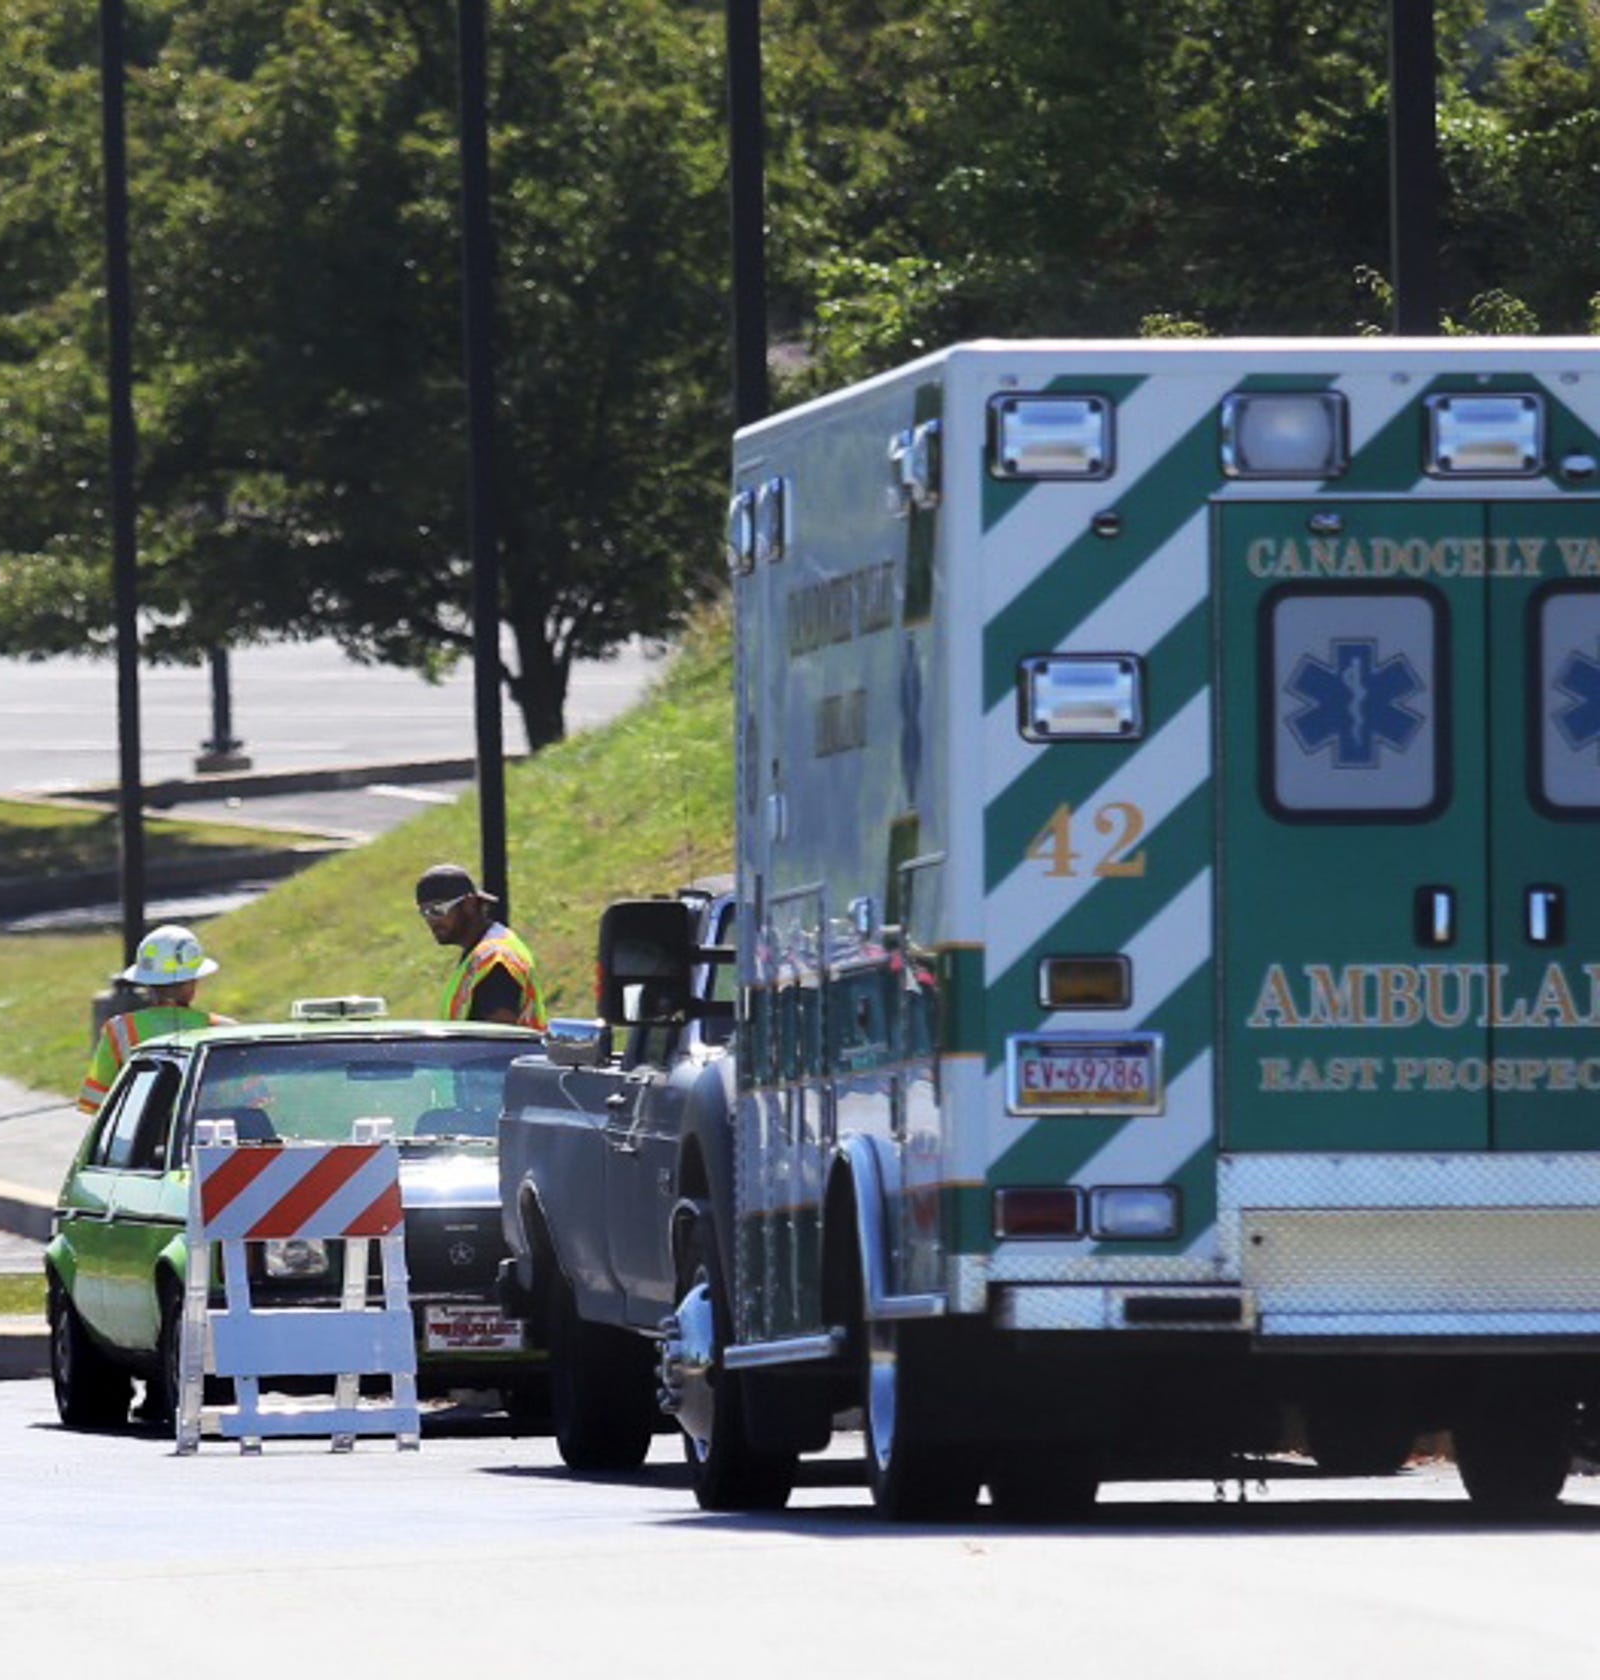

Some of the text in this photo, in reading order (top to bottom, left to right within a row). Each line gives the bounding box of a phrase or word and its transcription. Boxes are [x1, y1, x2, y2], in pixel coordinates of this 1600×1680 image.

[1025, 801, 1146, 878] 42
[1258, 1057, 1600, 1091] EAST PROSPEC
